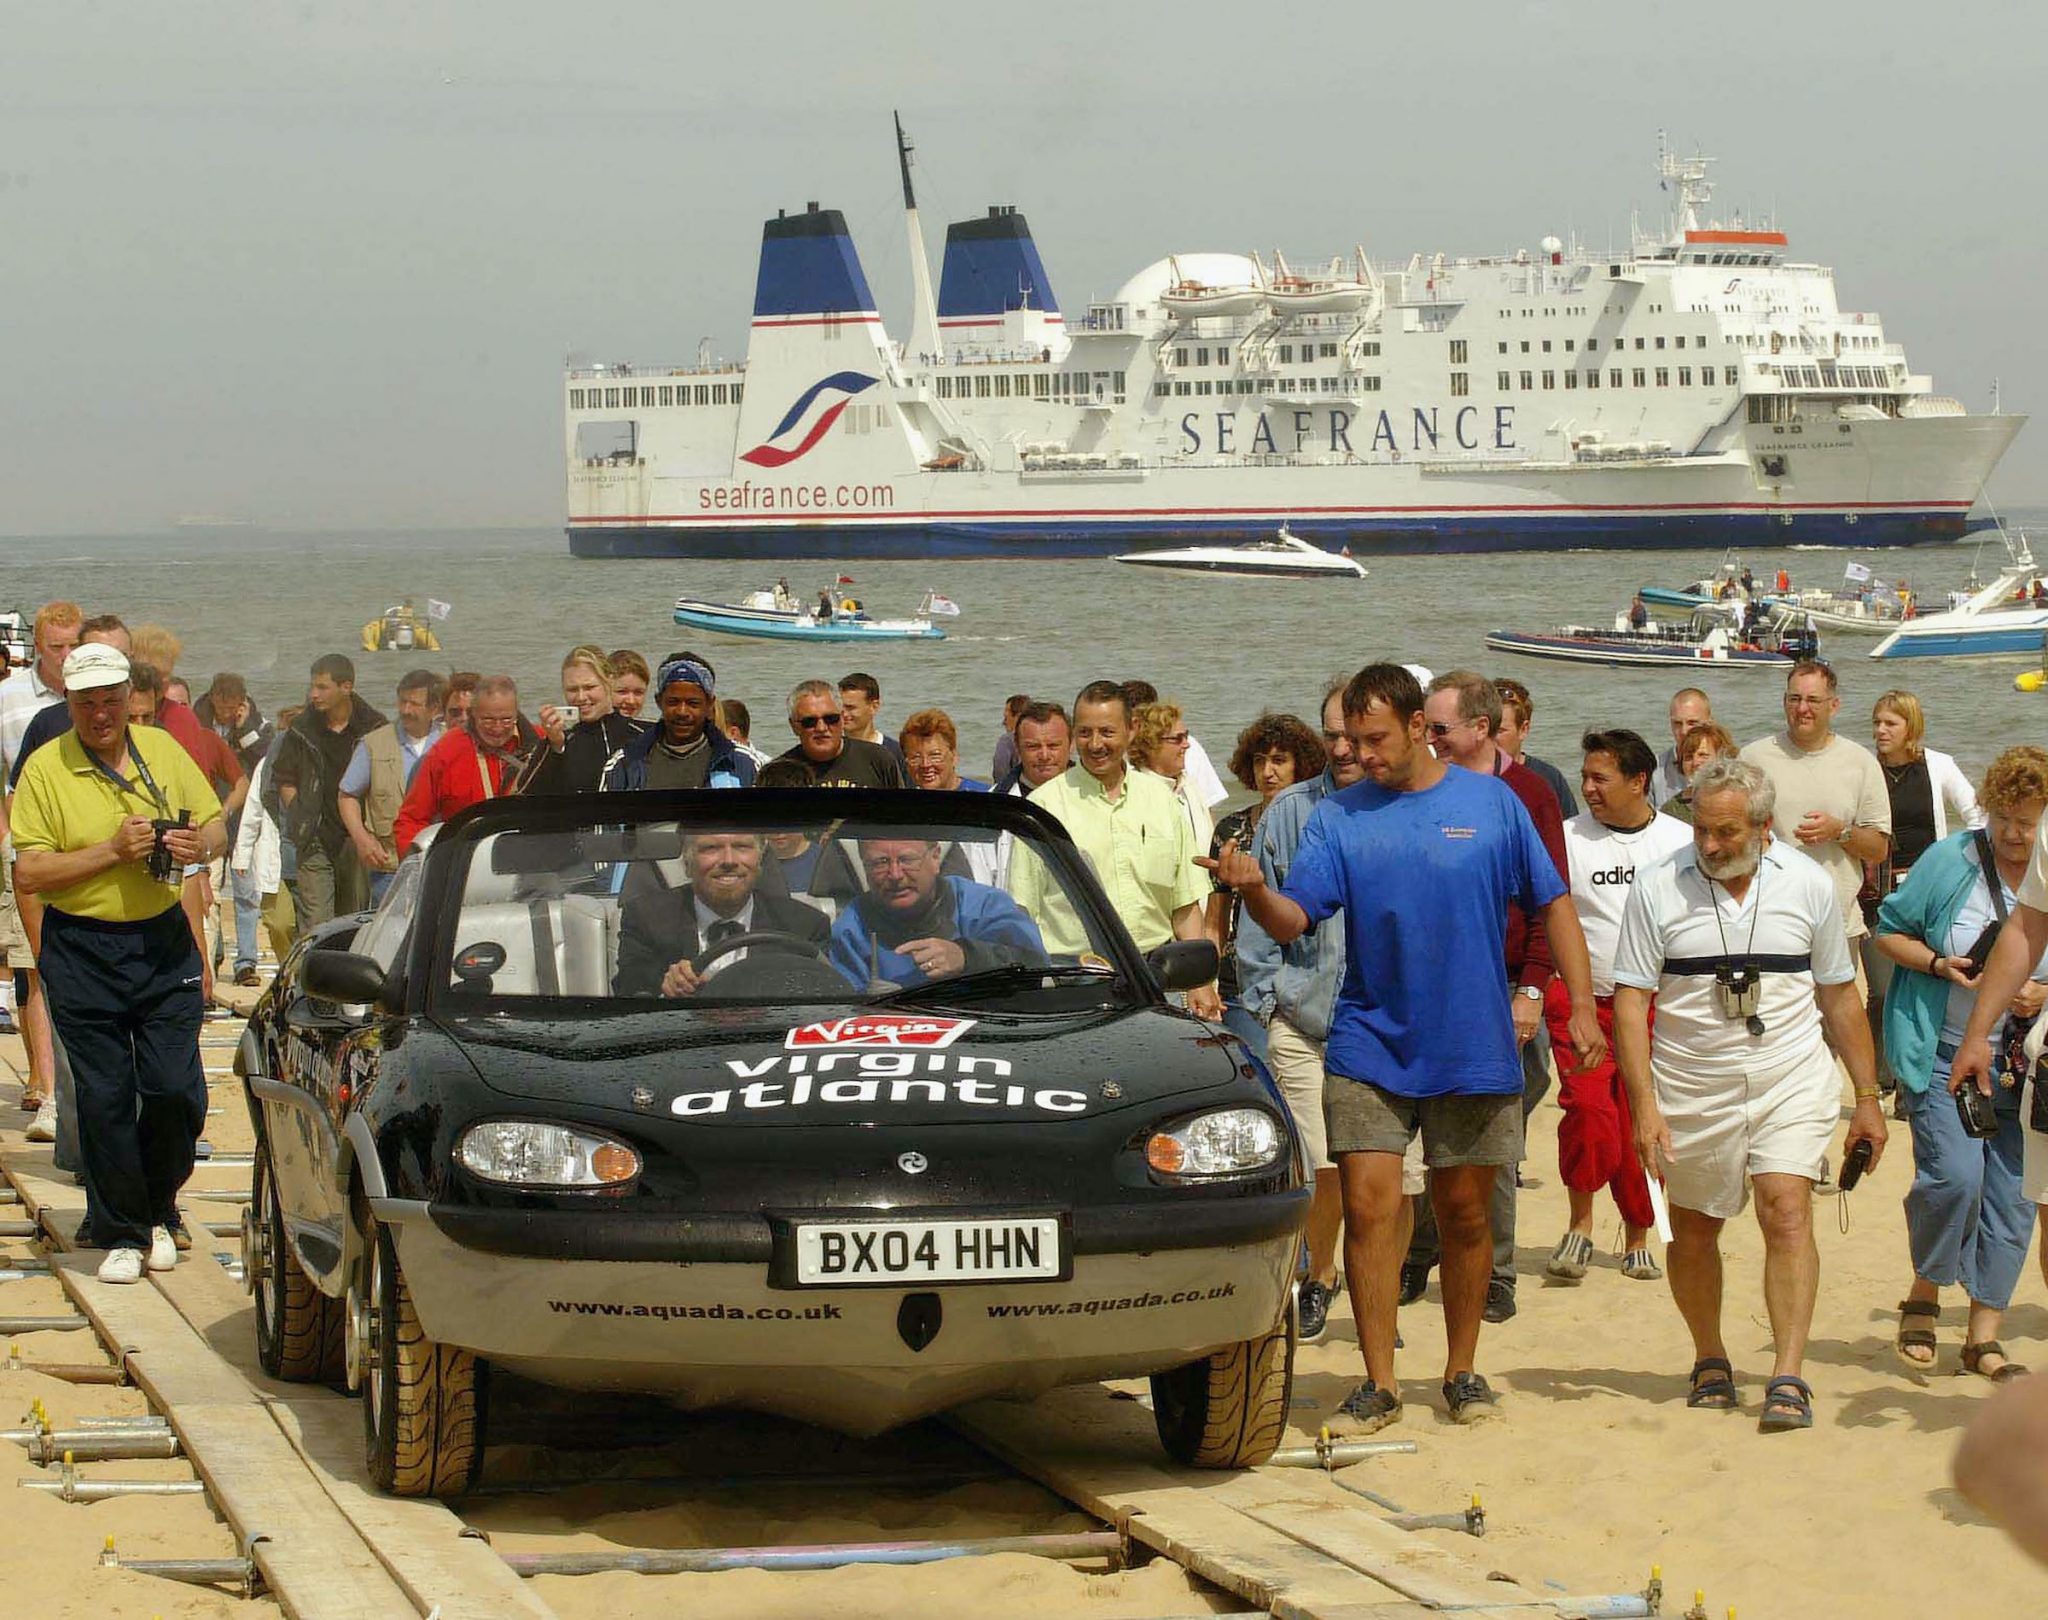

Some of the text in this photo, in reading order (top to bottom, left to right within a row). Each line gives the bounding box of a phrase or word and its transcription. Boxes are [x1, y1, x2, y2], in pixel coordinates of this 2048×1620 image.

[1181, 405, 1517, 455] SEAFRANCE
[699, 480, 895, 509] seafrance.com
[1592, 865, 1635, 885] adid
[802, 1017, 945, 1046] Virgin
[726, 1053, 1012, 1077] virgin
[671, 1074, 1089, 1116] atlantic
[820, 1226, 1041, 1273] BX04 HHN
[548, 1297, 843, 1323] www.aquada.co.uk
[986, 1281, 1238, 1319] www.aquada.co.uk
